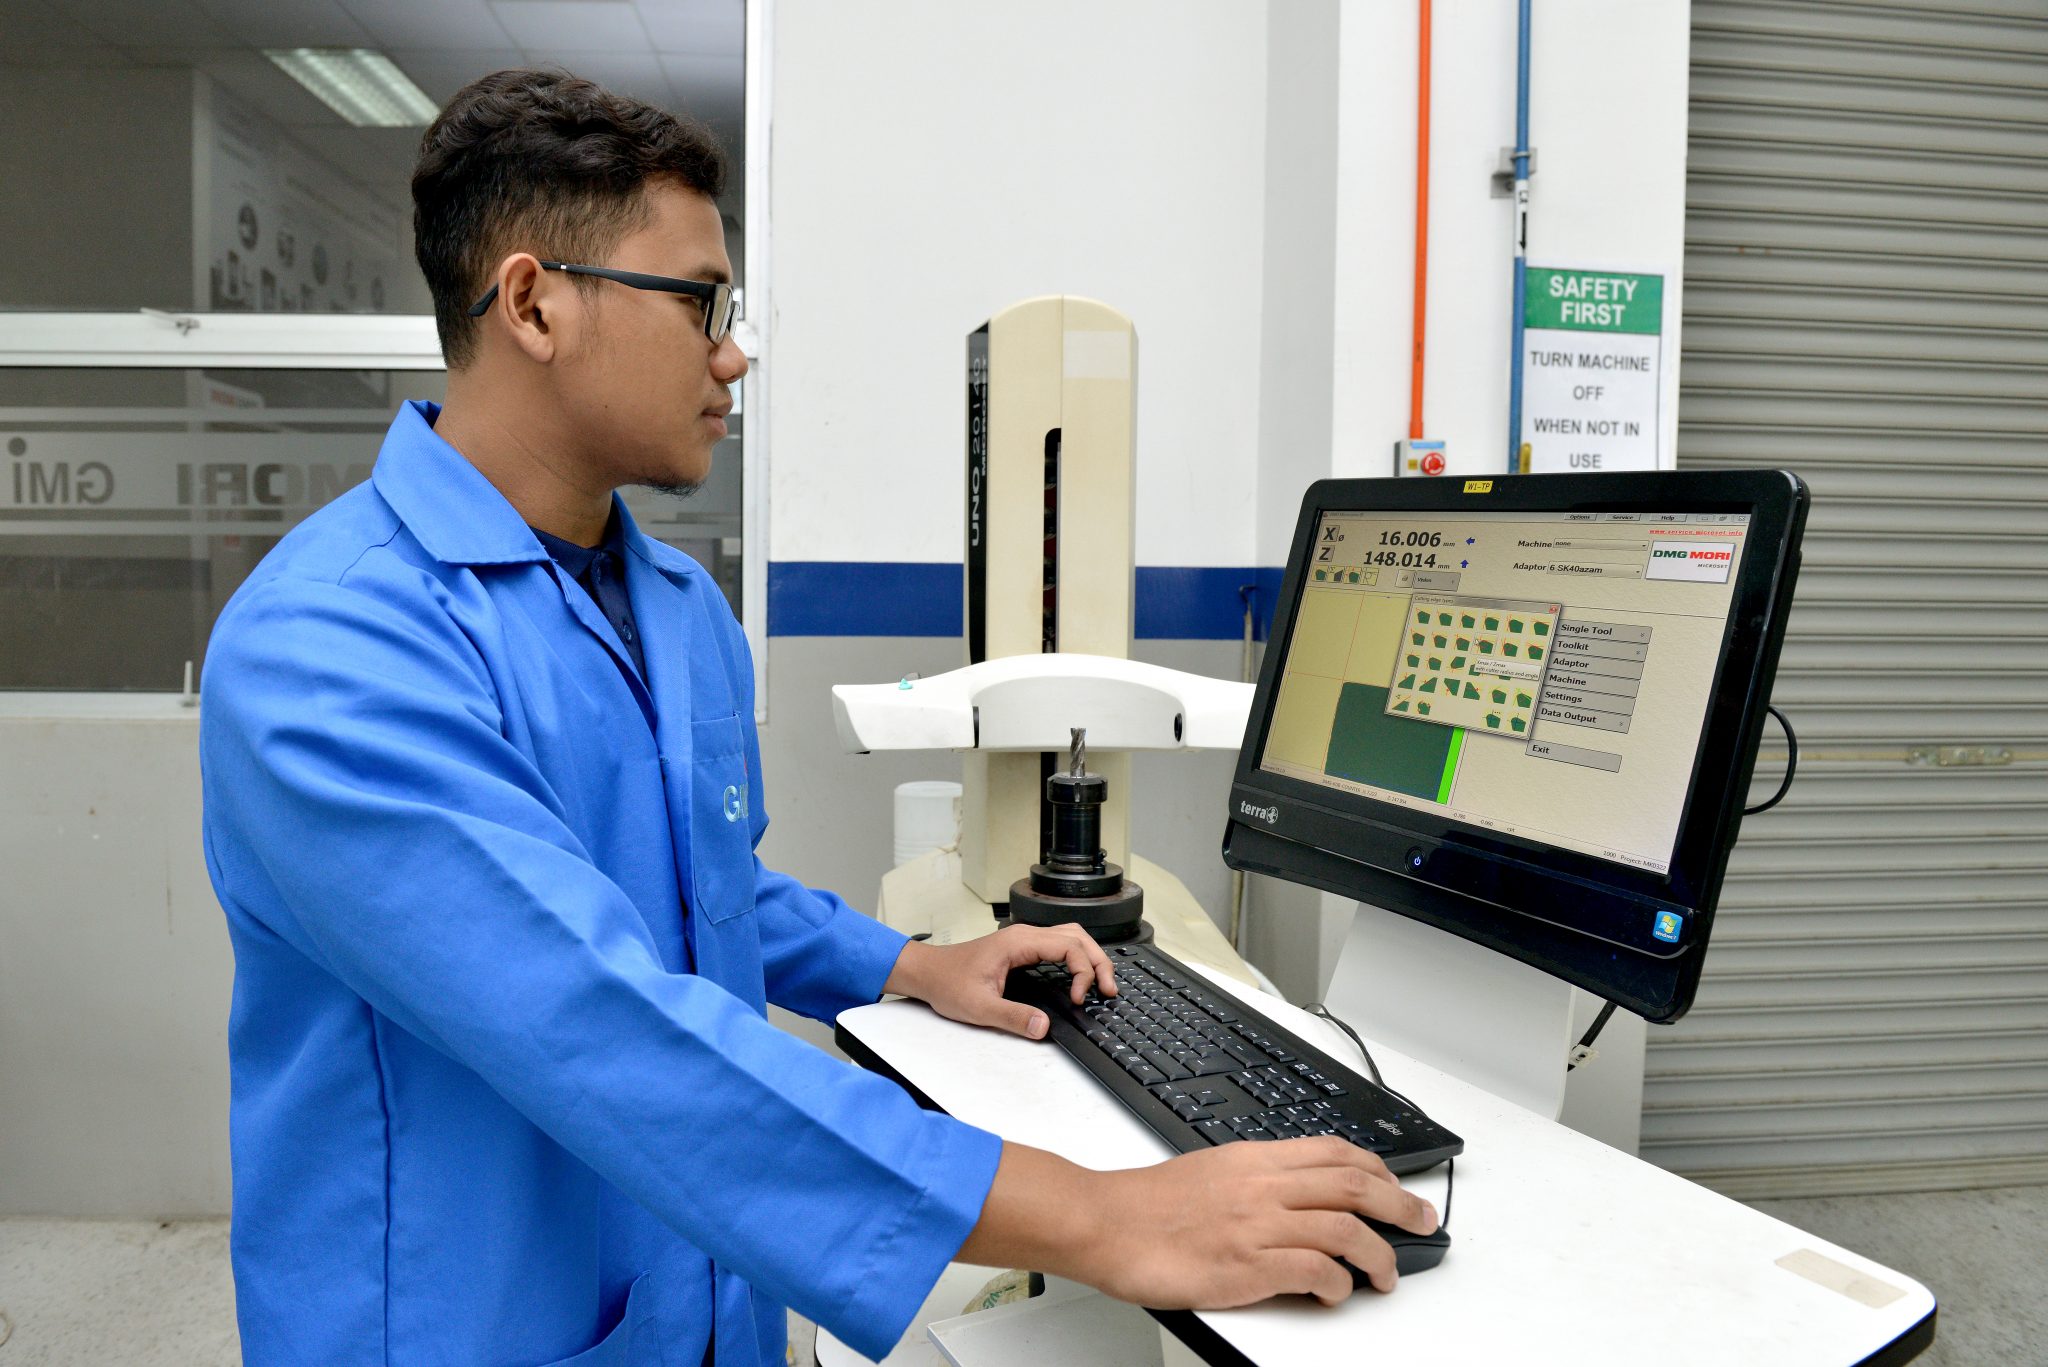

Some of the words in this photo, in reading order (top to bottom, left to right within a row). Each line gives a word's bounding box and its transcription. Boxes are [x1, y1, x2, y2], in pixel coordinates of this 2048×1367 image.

[1549, 274, 1638, 301] SAFETY
[1560, 301, 1626, 326] FIRST
[1530, 350, 1574, 368] TURN
[1578, 353, 1651, 372] MACHINE
[1573, 385, 1605, 401] OFF
[1534, 417, 1582, 434] WHEN
[1586, 419, 1620, 436] NOT
[1624, 421, 1640, 437] IN
[1569, 453, 1601, 469] USE
[972, 466, 980, 547] UNO
[1323, 526, 1337, 541] X
[1378, 531, 1442, 548] 16.006
[1517, 540, 1552, 549] Machine
[1318, 547, 1331, 562] Z
[1363, 551, 1437, 569] 148.014
[1652, 550, 1688, 559] DMG
[1689, 551, 1731, 561] MORI
[1513, 562, 1547, 572] Adaptor
[1549, 564, 1556, 572] 6
[1557, 564, 1603, 574] SK40azam
[1561, 623, 1589, 636] Single
[1591, 625, 1612, 636] Tool
[1557, 640, 1589, 651] Toolkit
[1552, 657, 1590, 669] Adaptor
[1549, 674, 1587, 687] Machine
[1545, 691, 1582, 704] Settings
[1541, 707, 1562, 718] Data
[1564, 711, 1597, 725] Output
[1532, 744, 1550, 755] Exit
[1241, 800, 1267, 820] terra
[1375, 1118, 1404, 1136] FUJITSU
